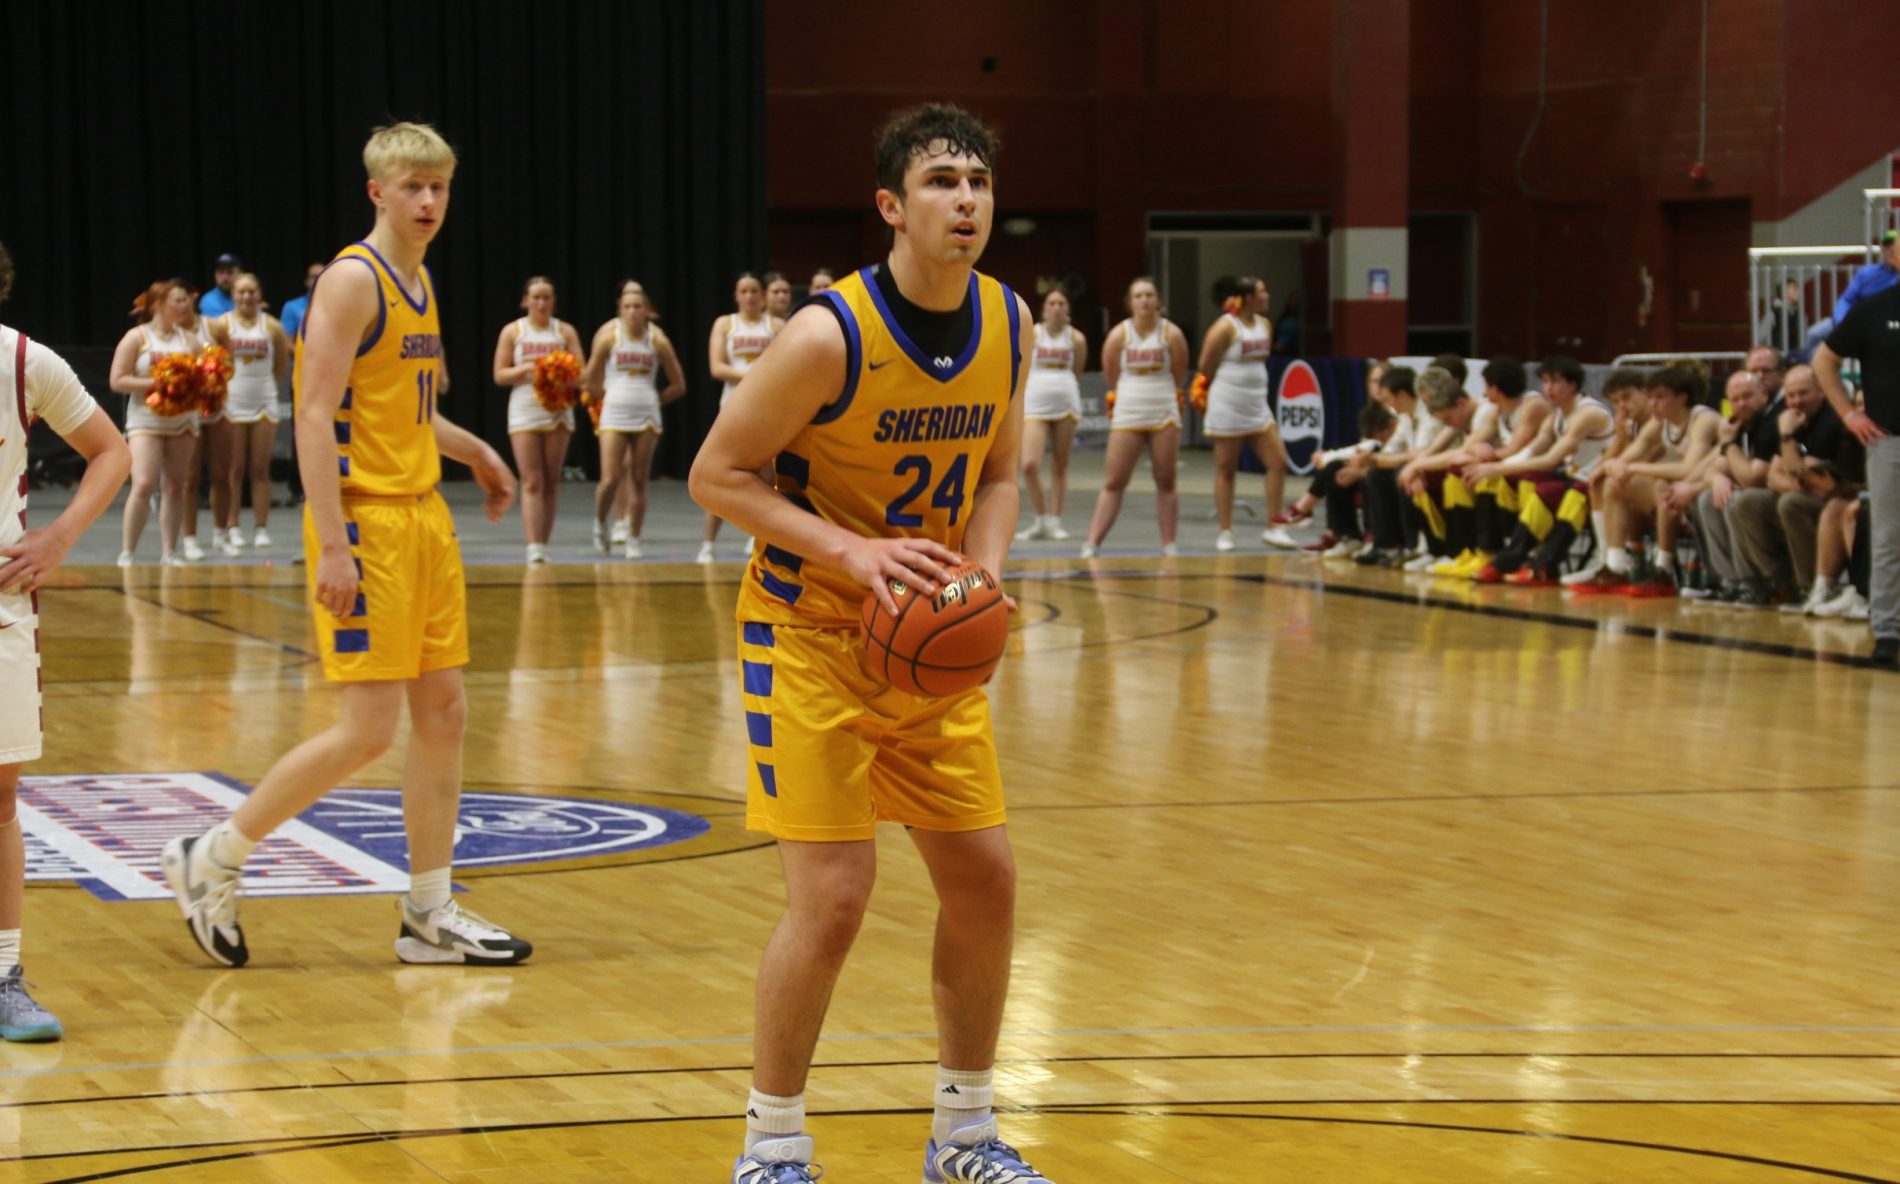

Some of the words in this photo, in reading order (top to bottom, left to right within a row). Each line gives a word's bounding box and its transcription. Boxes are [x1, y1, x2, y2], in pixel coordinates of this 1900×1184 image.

[416, 368, 433, 425] 11
[1281, 405, 1321, 428] PEPSI
[873, 403, 996, 443] SHERIDAN
[885, 452, 969, 528] 24
